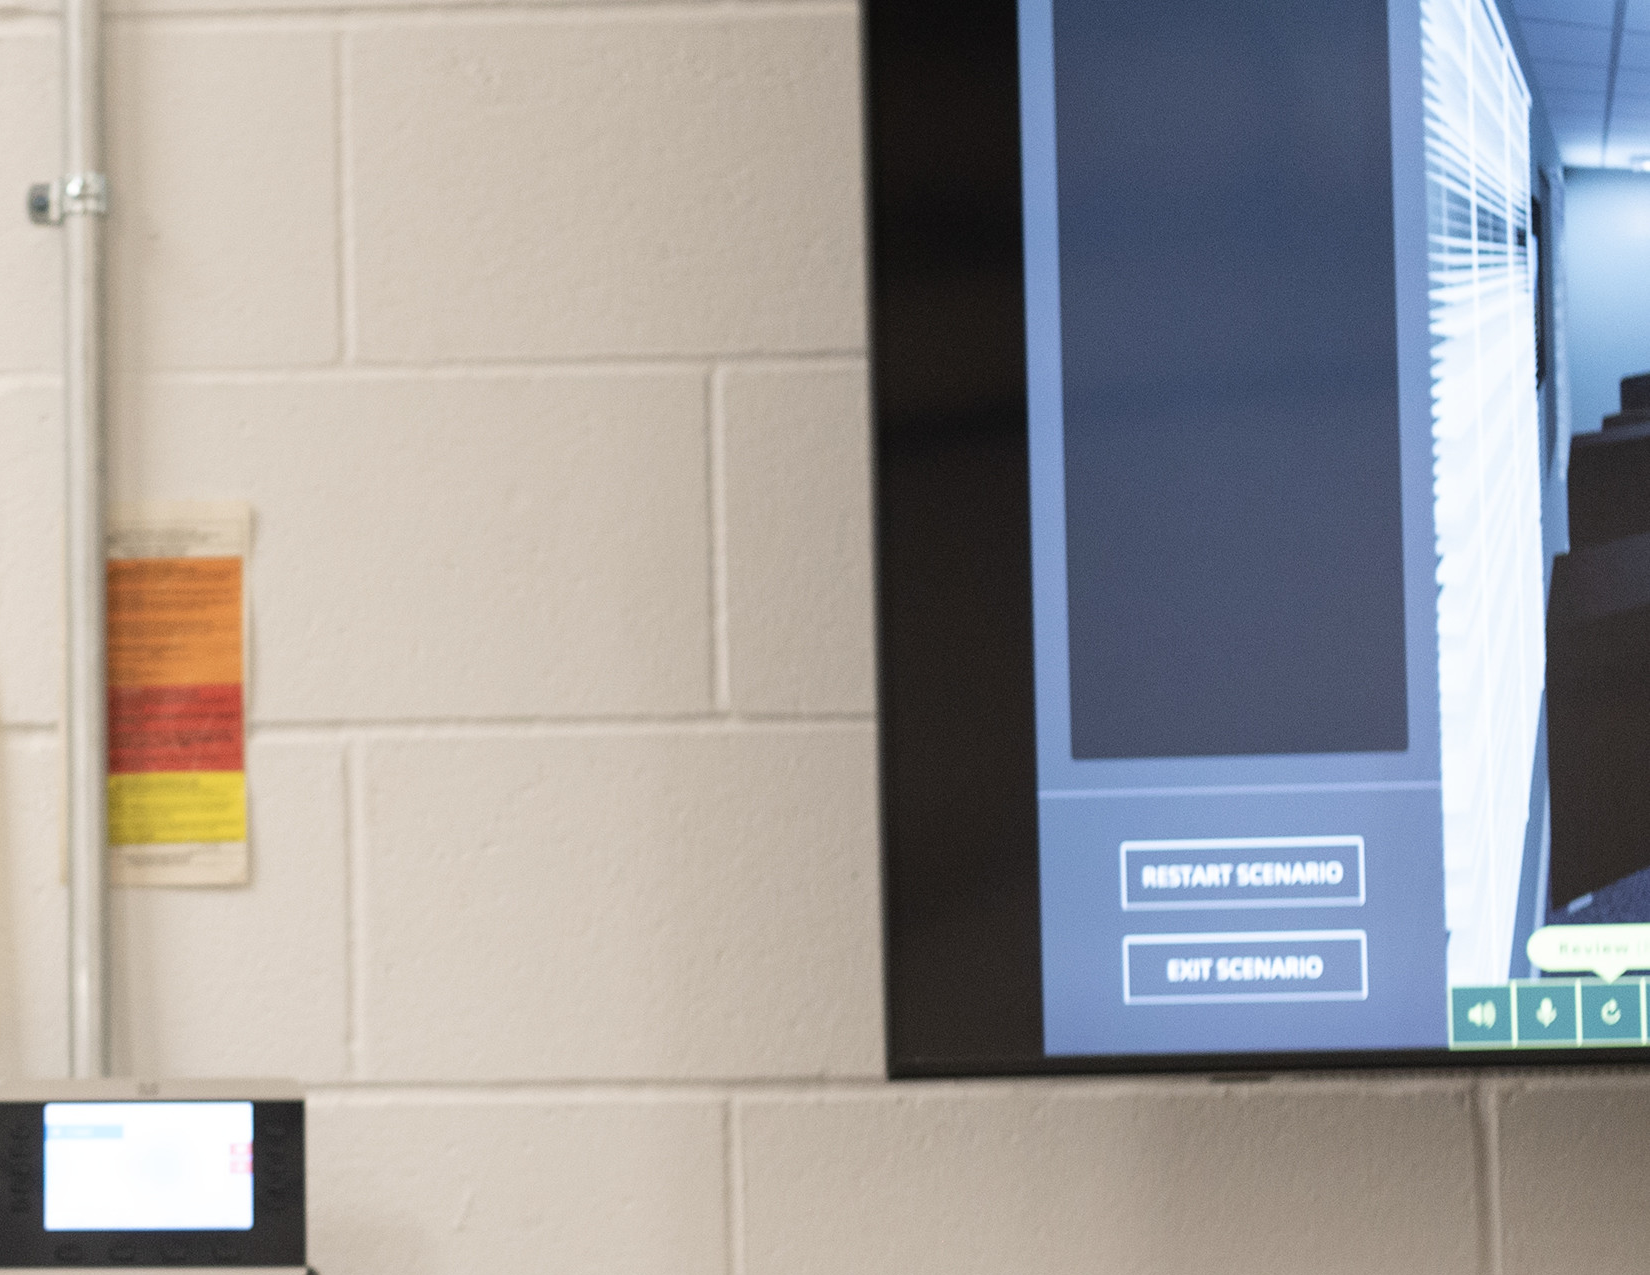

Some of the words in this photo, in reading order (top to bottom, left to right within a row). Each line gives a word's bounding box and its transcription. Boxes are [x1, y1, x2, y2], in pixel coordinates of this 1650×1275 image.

[1142, 863, 1233, 889] RESTART
[1236, 861, 1344, 887] SCENARIO
[1558, 940, 1630, 956] Review
[1166, 957, 1213, 982] EXIT
[1216, 955, 1324, 981] SCENARIO
